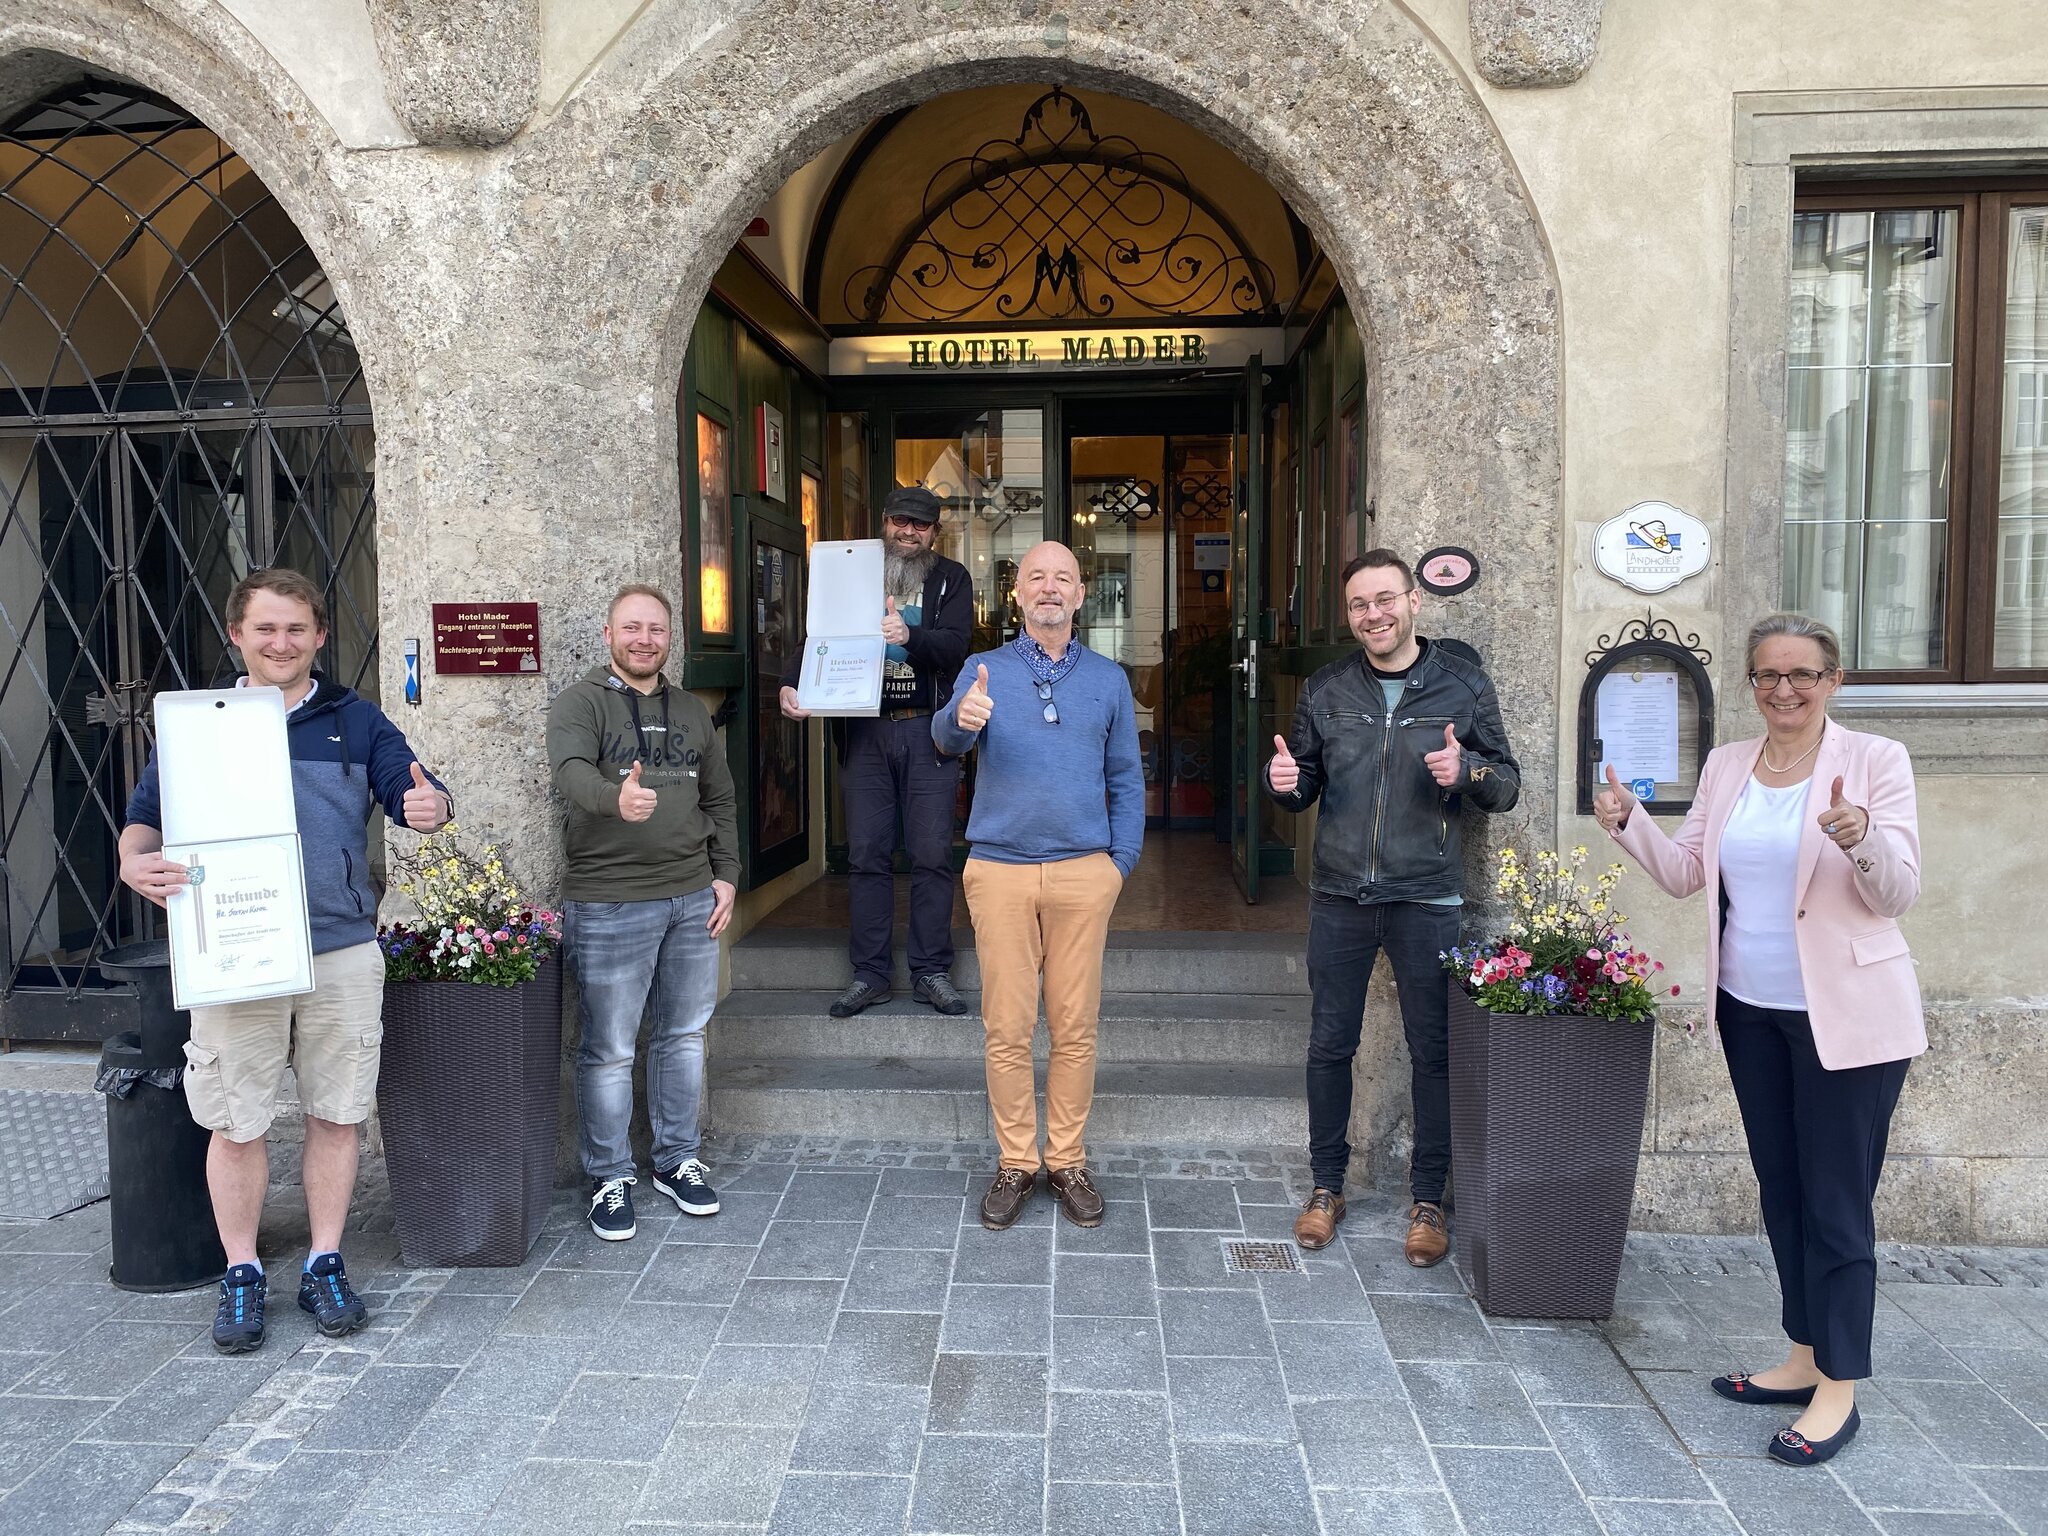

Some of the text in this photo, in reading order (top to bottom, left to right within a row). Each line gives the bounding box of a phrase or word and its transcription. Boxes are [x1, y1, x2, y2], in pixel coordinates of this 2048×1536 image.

[908, 334, 1207, 370] HOTEL MADER
[458, 613, 510, 621] Hotel Mader
[437, 623, 463, 632] Eingang
[467, 623, 496, 631] entrance
[500, 622, 533, 631] Rezeption
[439, 646, 483, 655] Nachteingang
[487, 646, 504, 654] night
[886, 681, 917, 692] PARKEN
[214, 888, 279, 905] Urkunde
